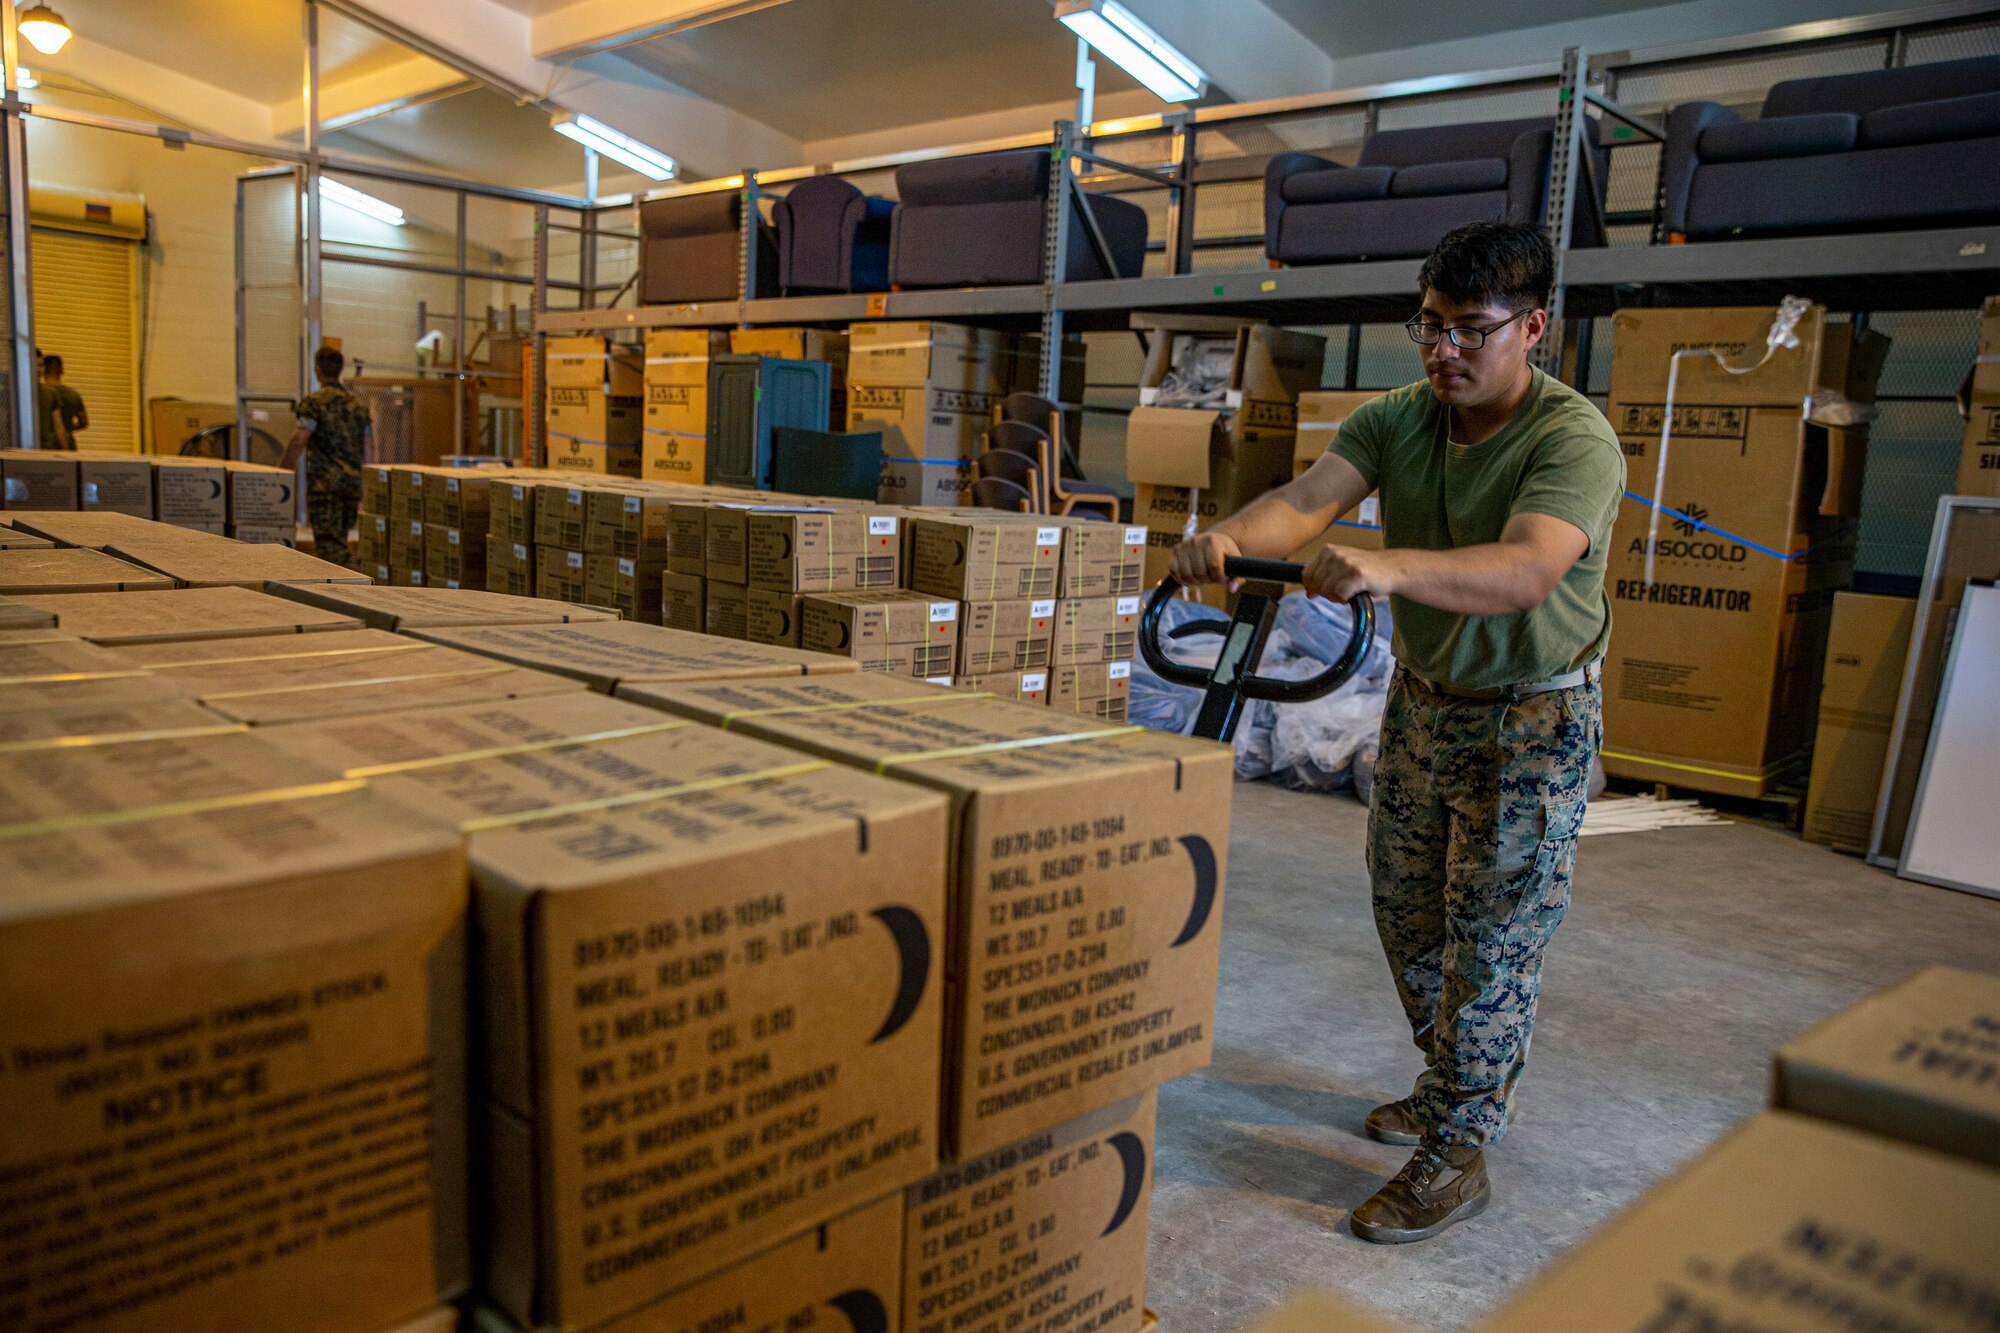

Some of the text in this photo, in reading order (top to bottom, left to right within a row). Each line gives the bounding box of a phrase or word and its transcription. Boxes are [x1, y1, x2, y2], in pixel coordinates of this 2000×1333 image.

[1980, 454, 2000, 469] SI
[1150, 498, 1217, 517] ABSOLD
[1616, 580, 1752, 613] REFRIGERATOR
[989, 865, 1034, 893] MEAL,
[989, 903, 1006, 926] 12
[1009, 890, 1059, 921] MEALS
[982, 958, 1150, 1024] THE WORNICK COMPANY
[1071, 1006, 1092, 1030] OH
[1094, 991, 1136, 1020] 45242
[612, 996, 689, 1042] MEALS
[977, 1006, 1175, 1089] U.S. GOVERNMENT PROPERTY
[103, 1058, 267, 1130] NOTICE
[975, 1022, 1203, 1121] COMMERCIAL RESALE IS UNLAWFUL
[582, 1060, 839, 1169] THE WORNICK COMPANY
[581, 1113, 877, 1247] U.S. GOVERNMENT PROPERTY
[582, 1123, 922, 1287] COMMERCIAL RESALE IS UNLAWFUL
[942, 1217, 989, 1251] MEALS
[1018, 1251, 1084, 1298] COMPANY
[1044, 1288, 1106, 1333] PROPERTY
